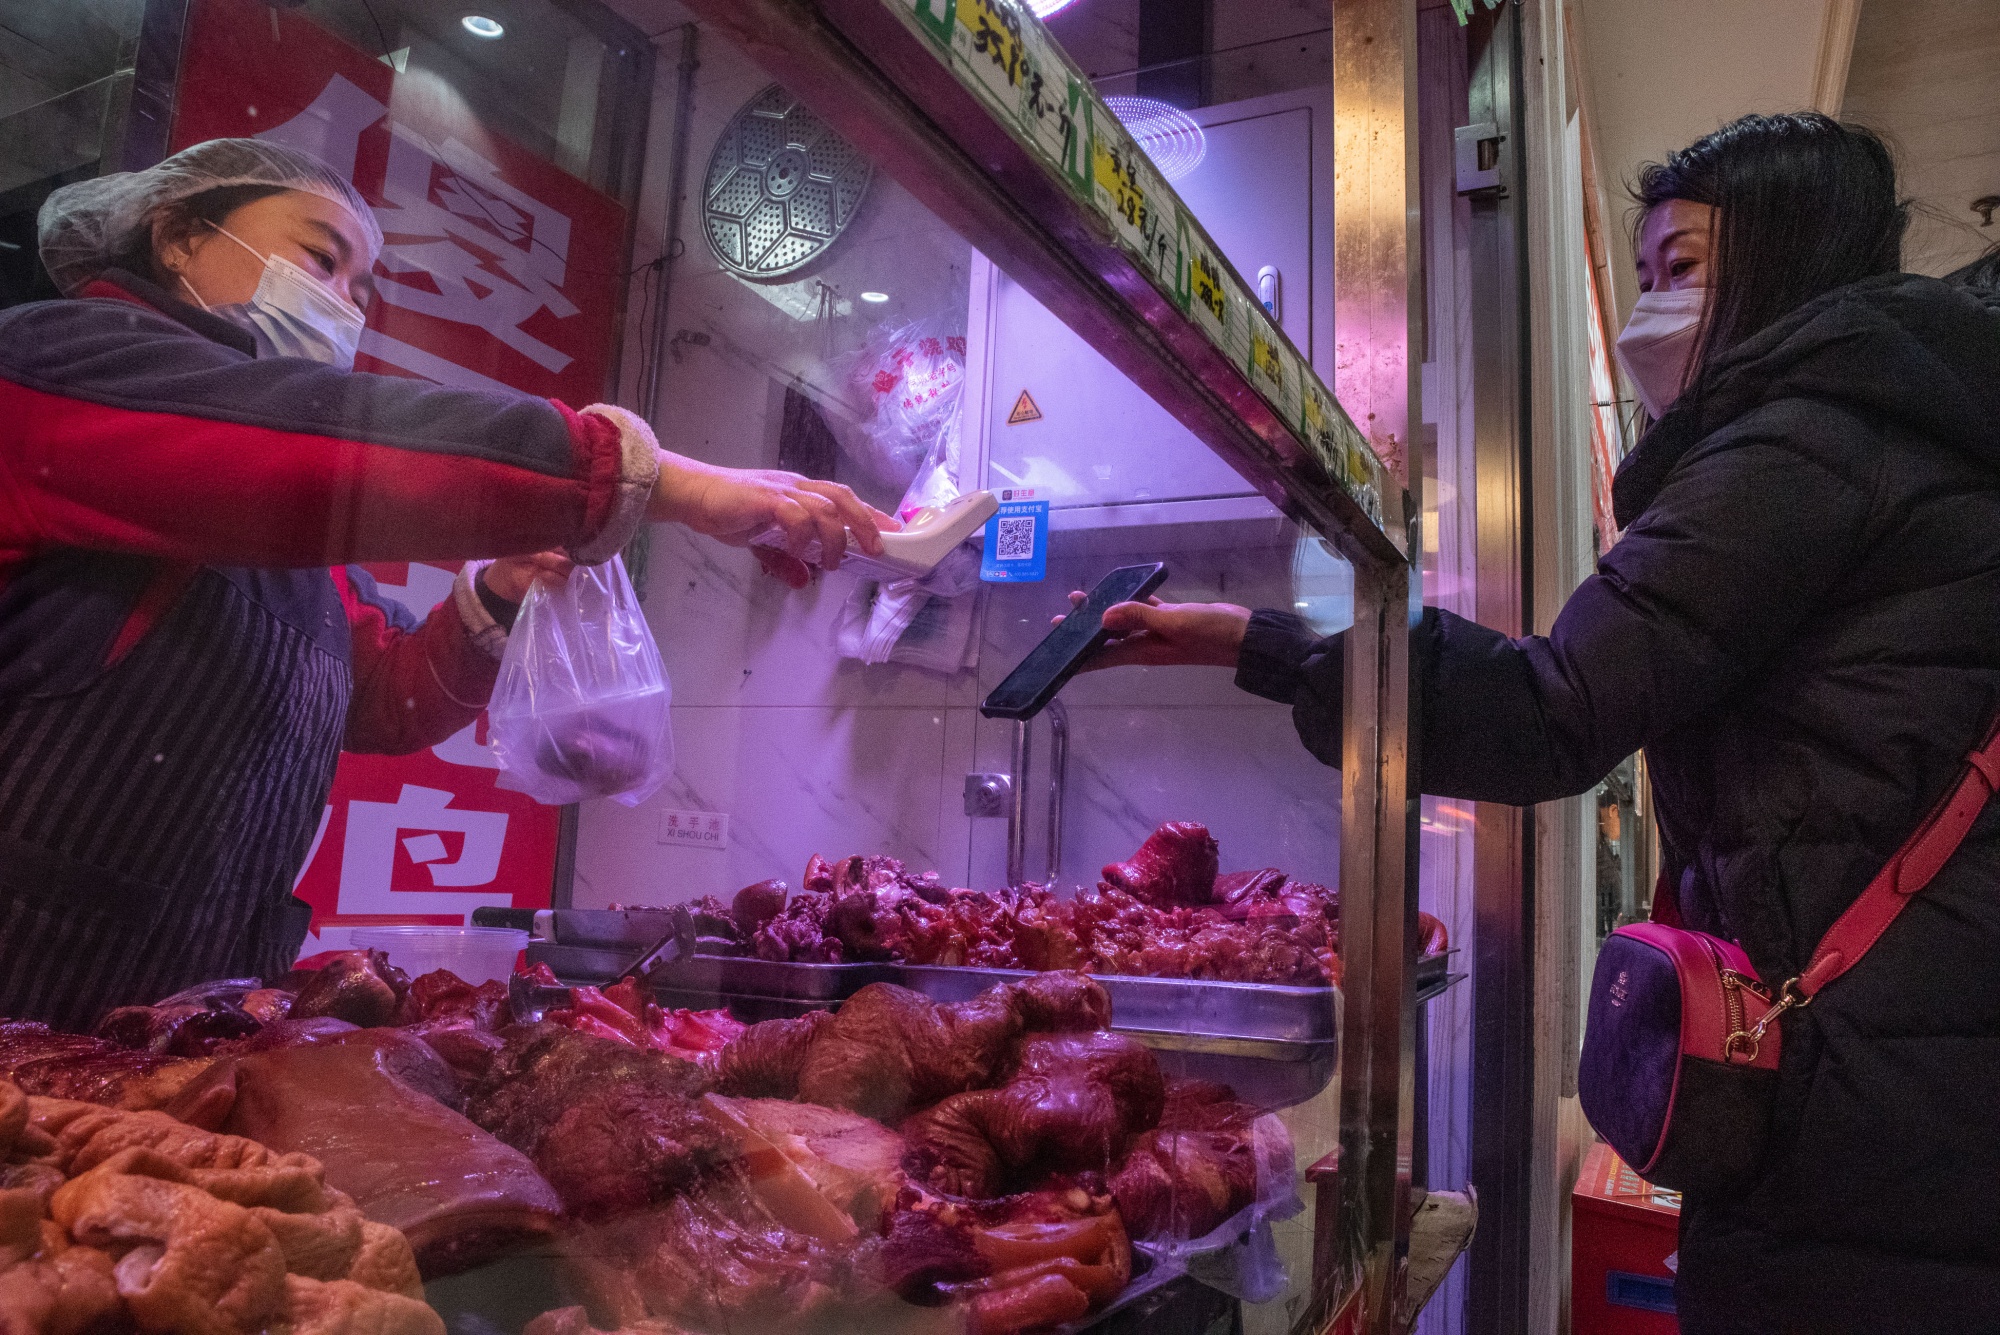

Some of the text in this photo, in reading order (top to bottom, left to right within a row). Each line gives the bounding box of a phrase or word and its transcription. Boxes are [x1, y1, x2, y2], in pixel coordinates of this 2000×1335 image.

[667, 814, 721, 831] 洗手池
[666, 828, 719, 841] XI SHOU CHI
